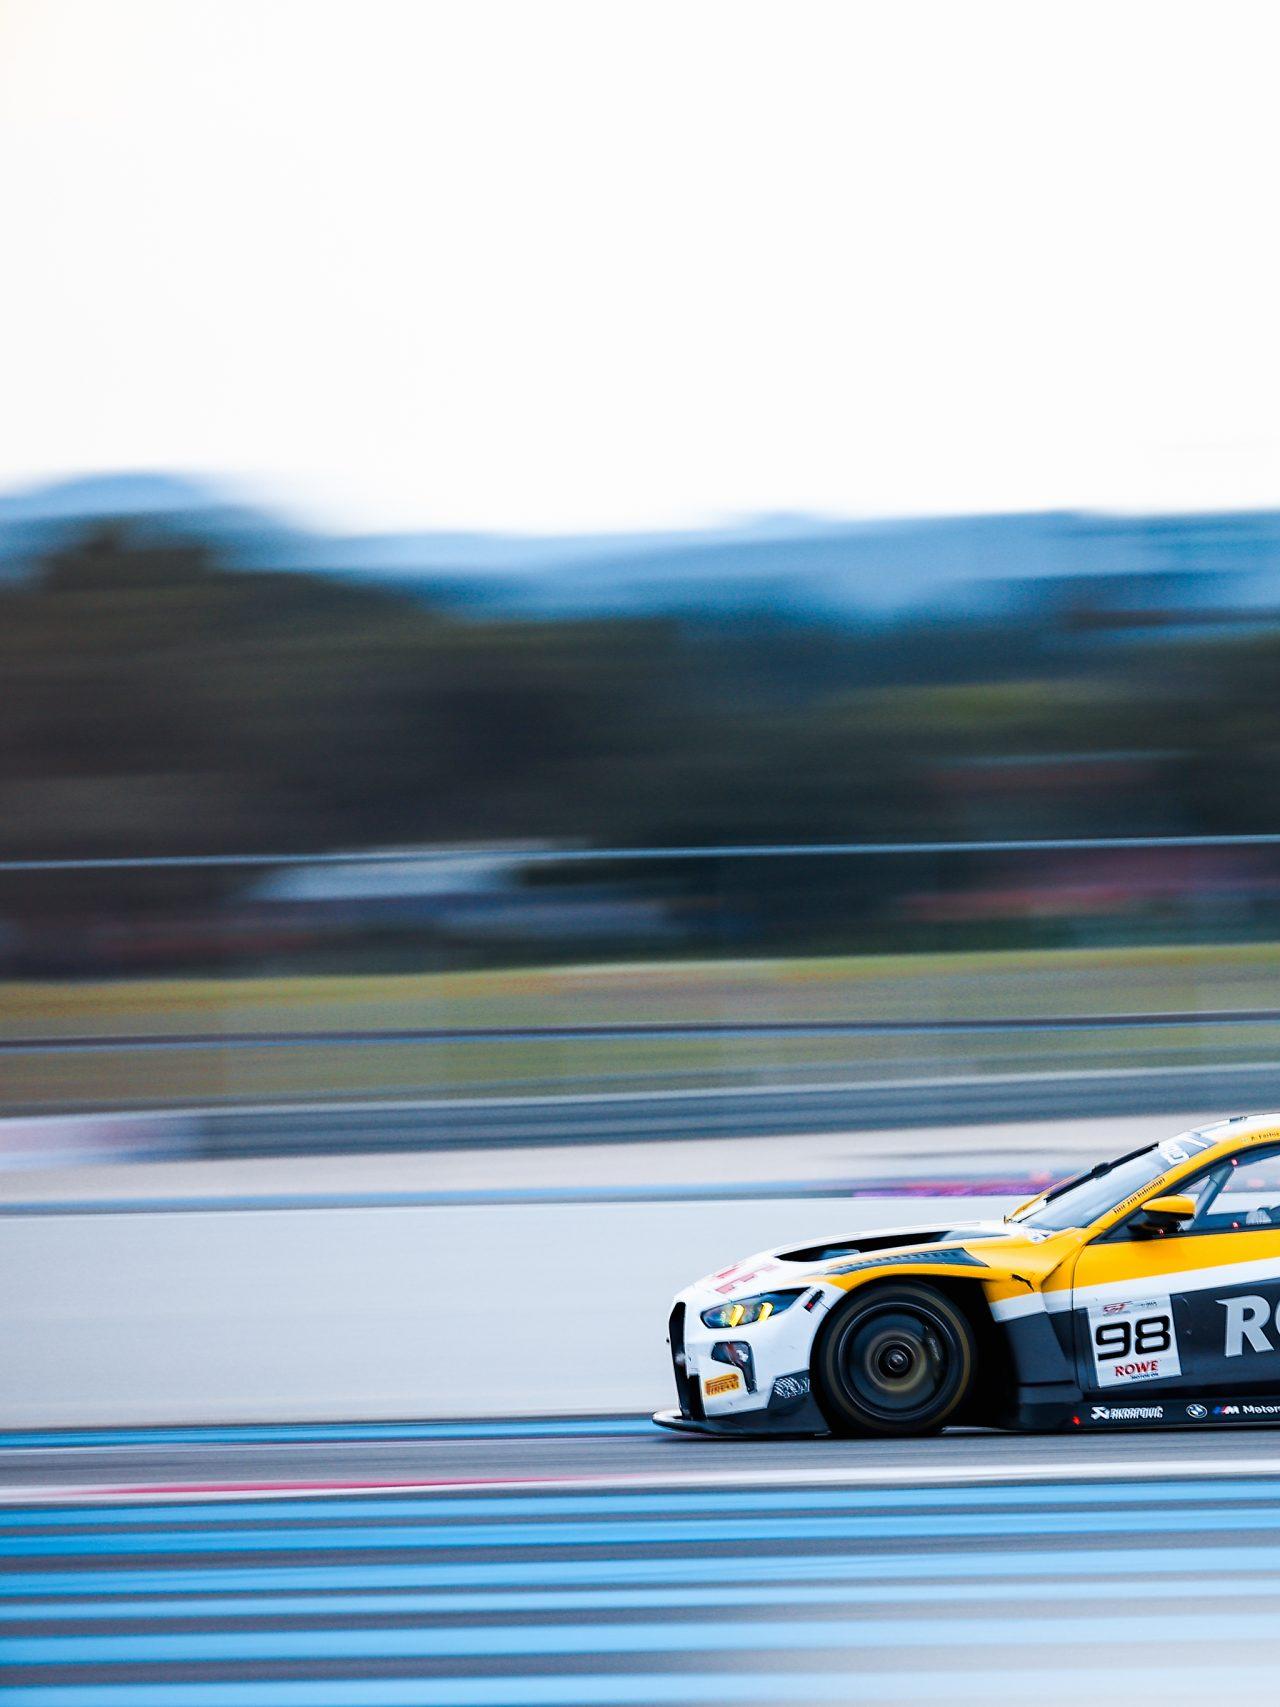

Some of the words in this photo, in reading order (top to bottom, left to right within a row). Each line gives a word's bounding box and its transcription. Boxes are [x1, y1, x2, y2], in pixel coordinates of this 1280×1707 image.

[1096, 1315, 1171, 1362] 98
[1114, 1360, 1159, 1377] ROWE
[705, 1373, 740, 1397] PIRELLI
